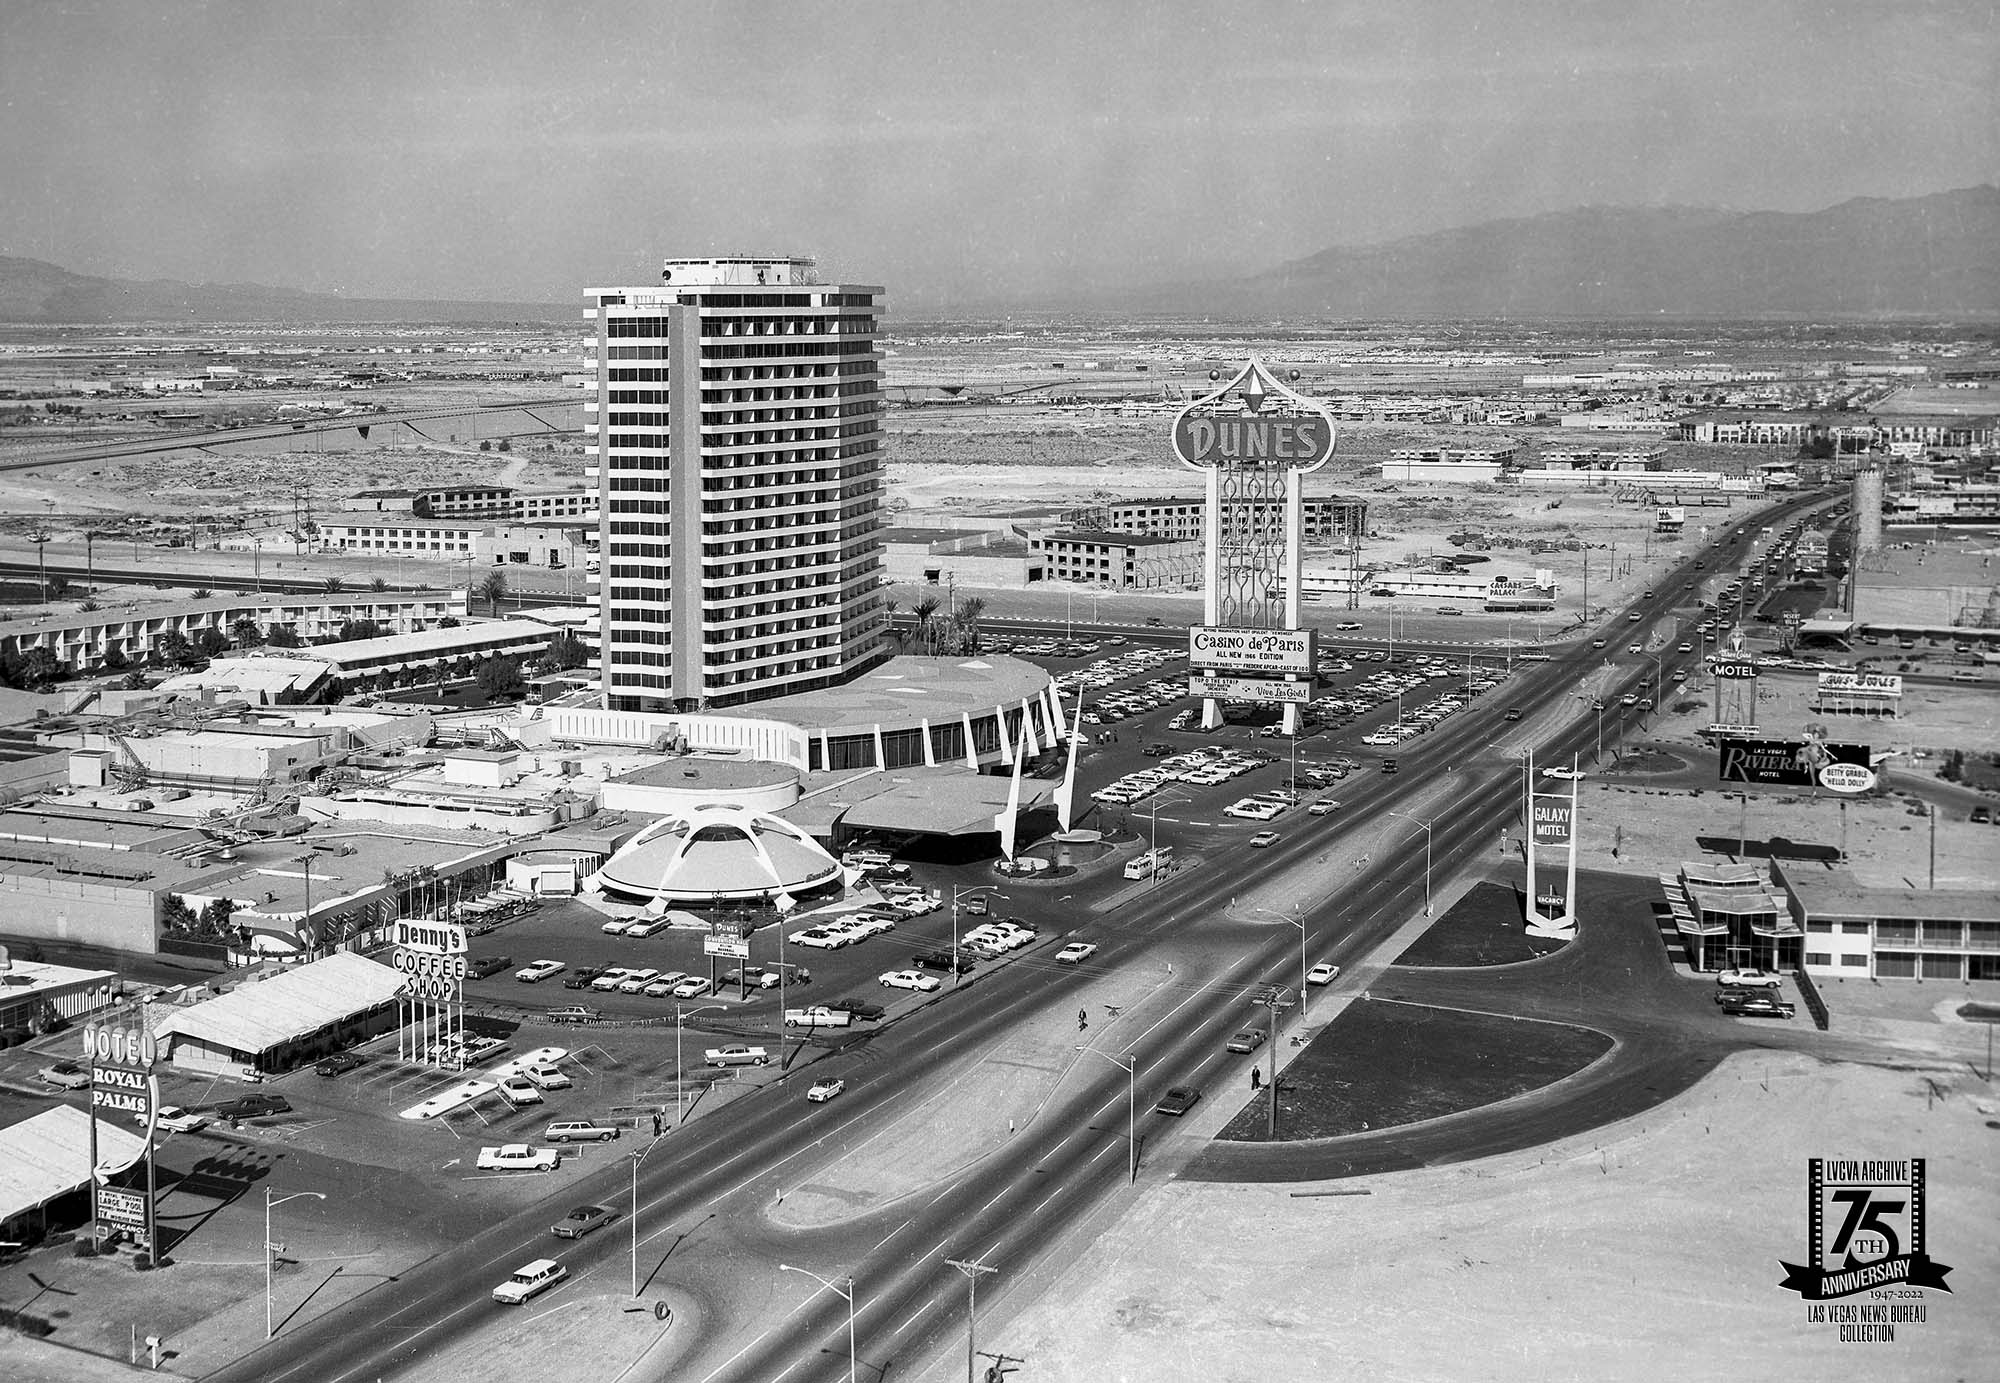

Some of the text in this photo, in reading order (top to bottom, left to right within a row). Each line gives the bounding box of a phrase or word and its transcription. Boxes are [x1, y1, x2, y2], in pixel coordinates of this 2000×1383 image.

[1187, 418, 1318, 460] DUNES
[1248, 636, 1262, 650] de
[1262, 636, 1305, 652] Paris
[1216, 650, 1228, 658] ALL
[1229, 651, 1242, 659] NEW
[1259, 652, 1284, 660] EDITION
[1715, 665, 1757, 676] MOTEL
[1256, 686, 1274, 696] Vive
[1275, 687, 1286, 697] Les
[1721, 747, 1800, 783] RIVIERA
[1826, 768, 1868, 778] BETTY GRABLE
[1534, 807, 1570, 823] GALAXY
[1536, 824, 1568, 837] MOTEL
[1537, 896, 1564, 905] VACANCY
[398, 923, 460, 953] Denny's
[394, 952, 463, 978] COFFEE
[407, 977, 452, 998] SHOP
[84, 1028, 154, 1068] MOTEL
[93, 1067, 146, 1090] ROYAL
[92, 1090, 147, 1113] PALMS
[99, 1197, 143, 1212] LARGE POOL
[111, 1222, 147, 1235] VACANCY
